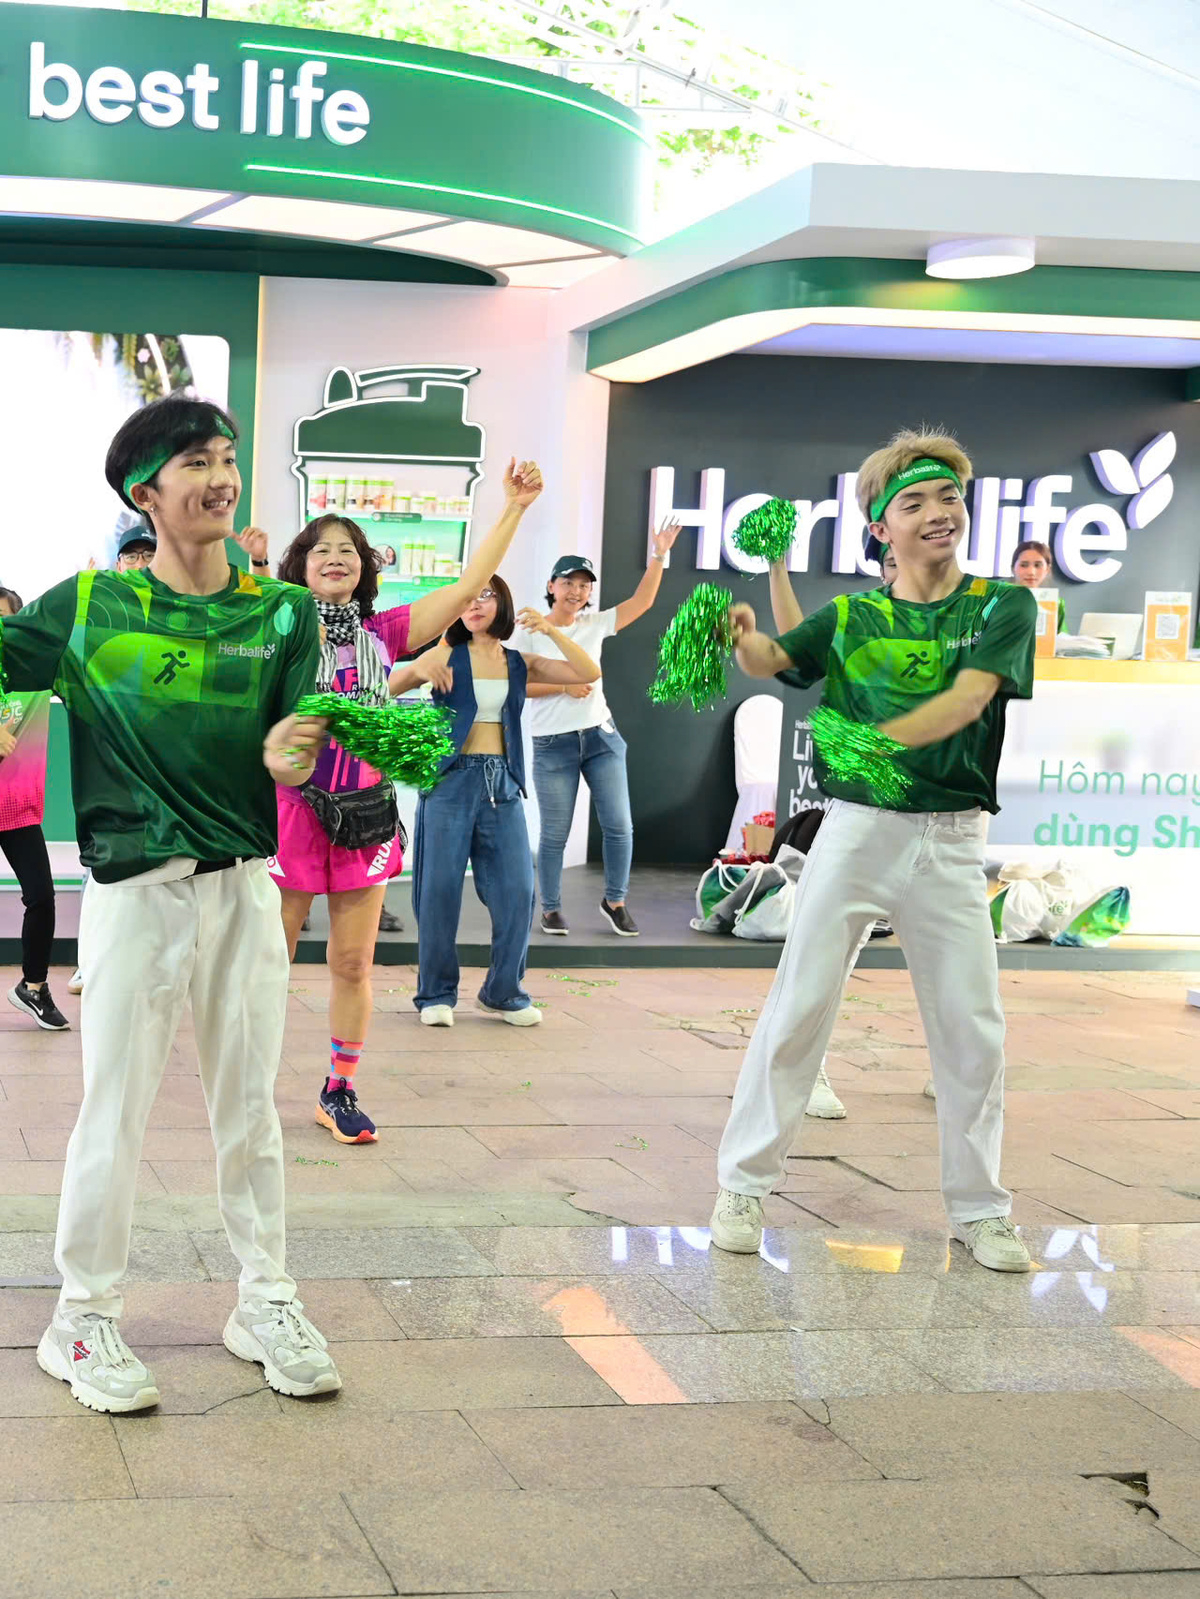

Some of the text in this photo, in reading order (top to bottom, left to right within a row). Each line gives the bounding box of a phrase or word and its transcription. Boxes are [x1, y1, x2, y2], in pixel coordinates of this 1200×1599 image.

[28, 41, 219, 130] best
[239, 59, 371, 146] life
[646, 465, 1128, 583] Hrlife
[218, 642, 271, 660] Herbalife
[792, 730, 814, 761] Li
[796, 765, 819, 795] yo
[1038, 759, 1125, 795] Hôm
[1033, 813, 1140, 858] dùng
[371, 837, 395, 871] RU
